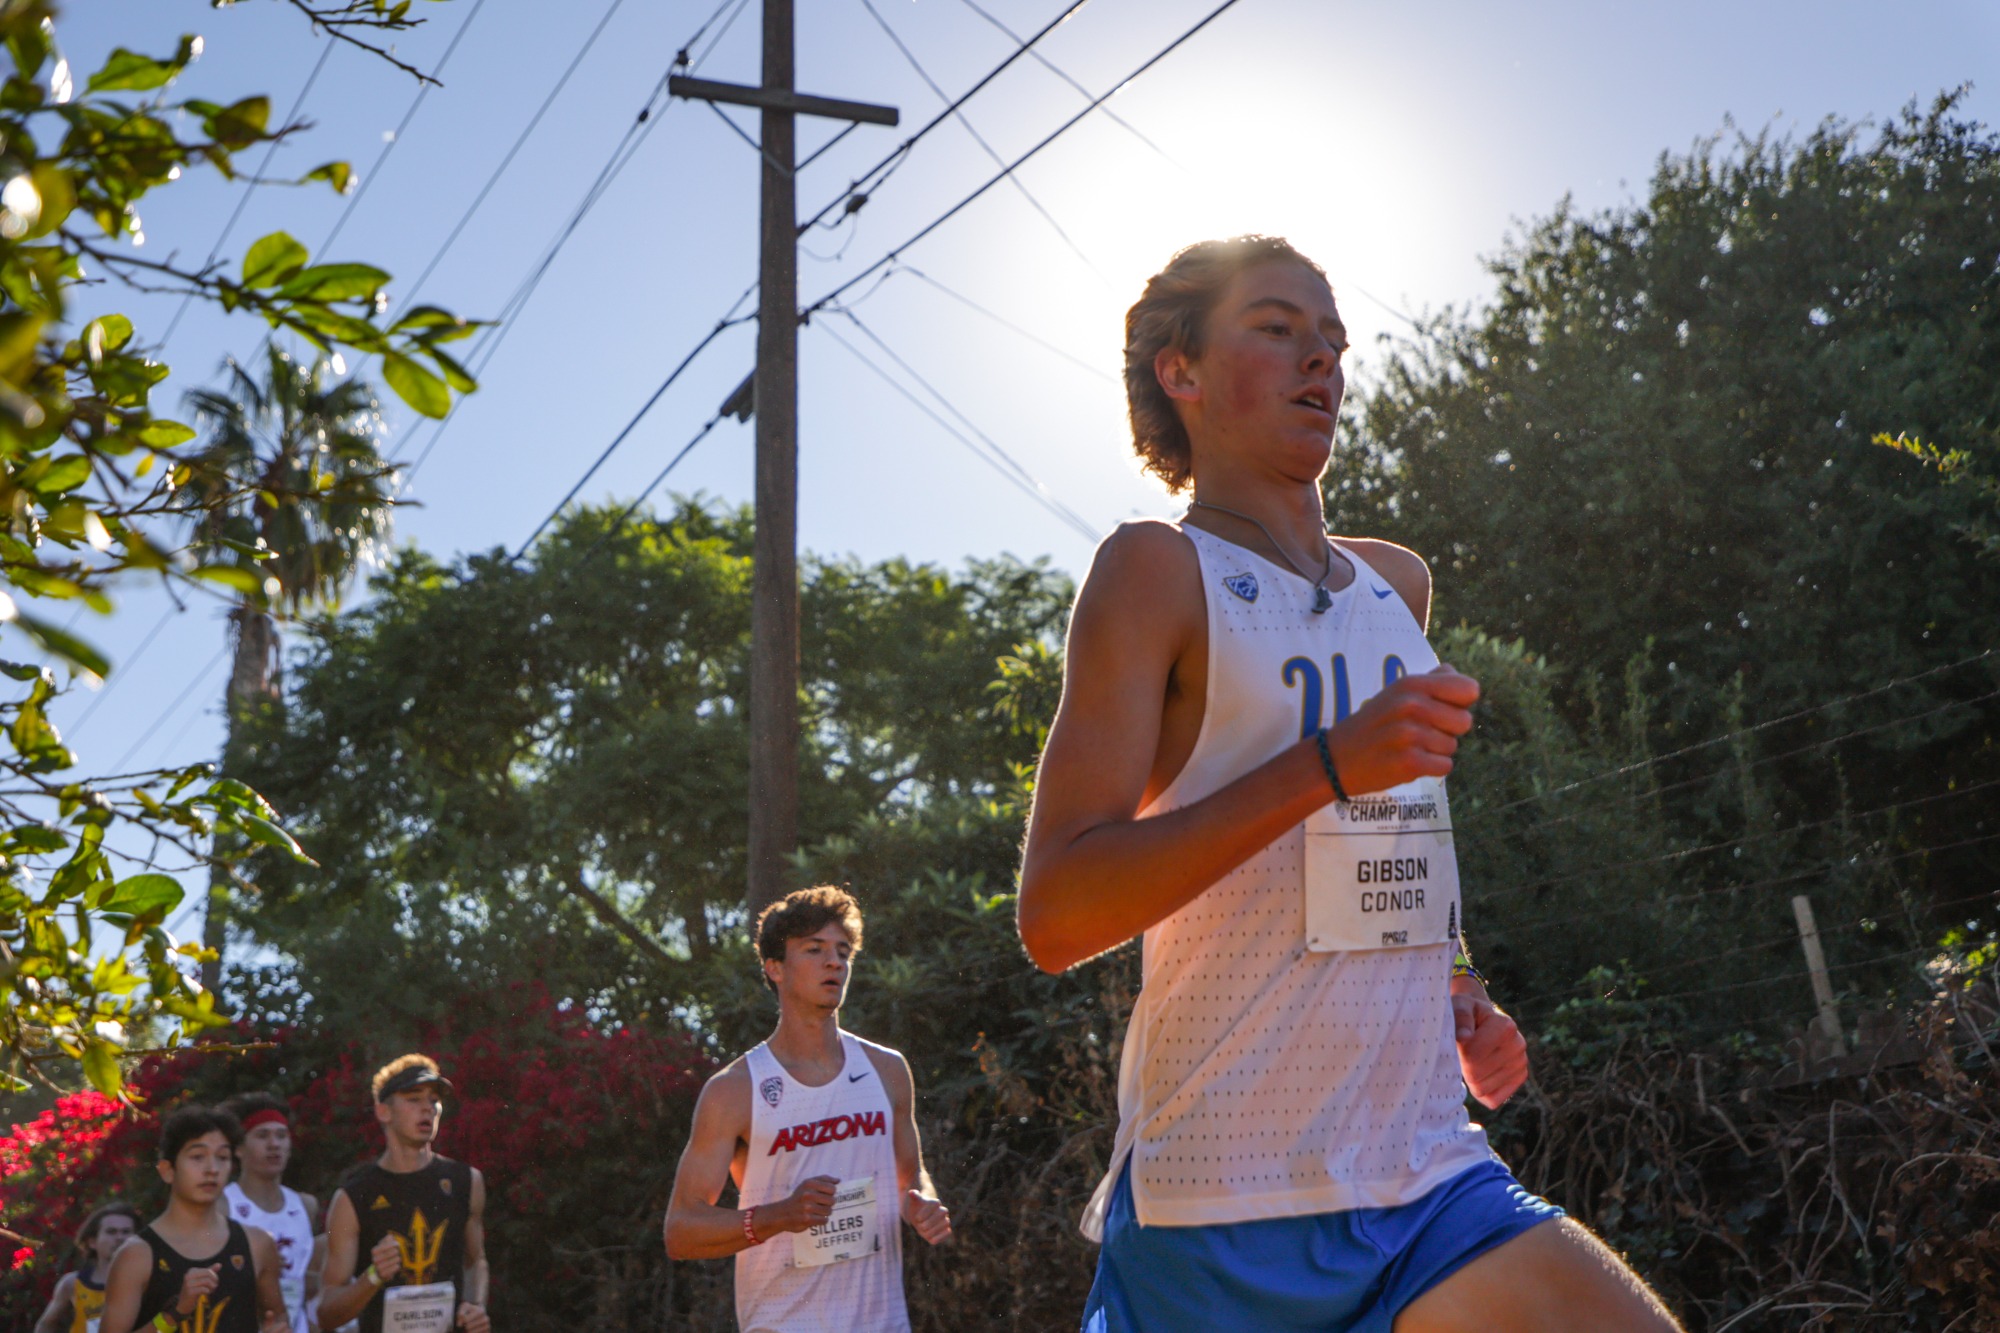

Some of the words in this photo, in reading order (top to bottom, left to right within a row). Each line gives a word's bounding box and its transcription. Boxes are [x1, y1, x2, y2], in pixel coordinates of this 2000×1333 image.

[1350, 803, 1438, 822] CHAMPIONSHIPS
[1357, 856, 1428, 883] GIBSON
[1361, 888, 1425, 912] CONOR
[767, 1111, 886, 1156] ARIZONA
[810, 1215, 863, 1236] SILLERS
[815, 1231, 863, 1249] JEFFREY
